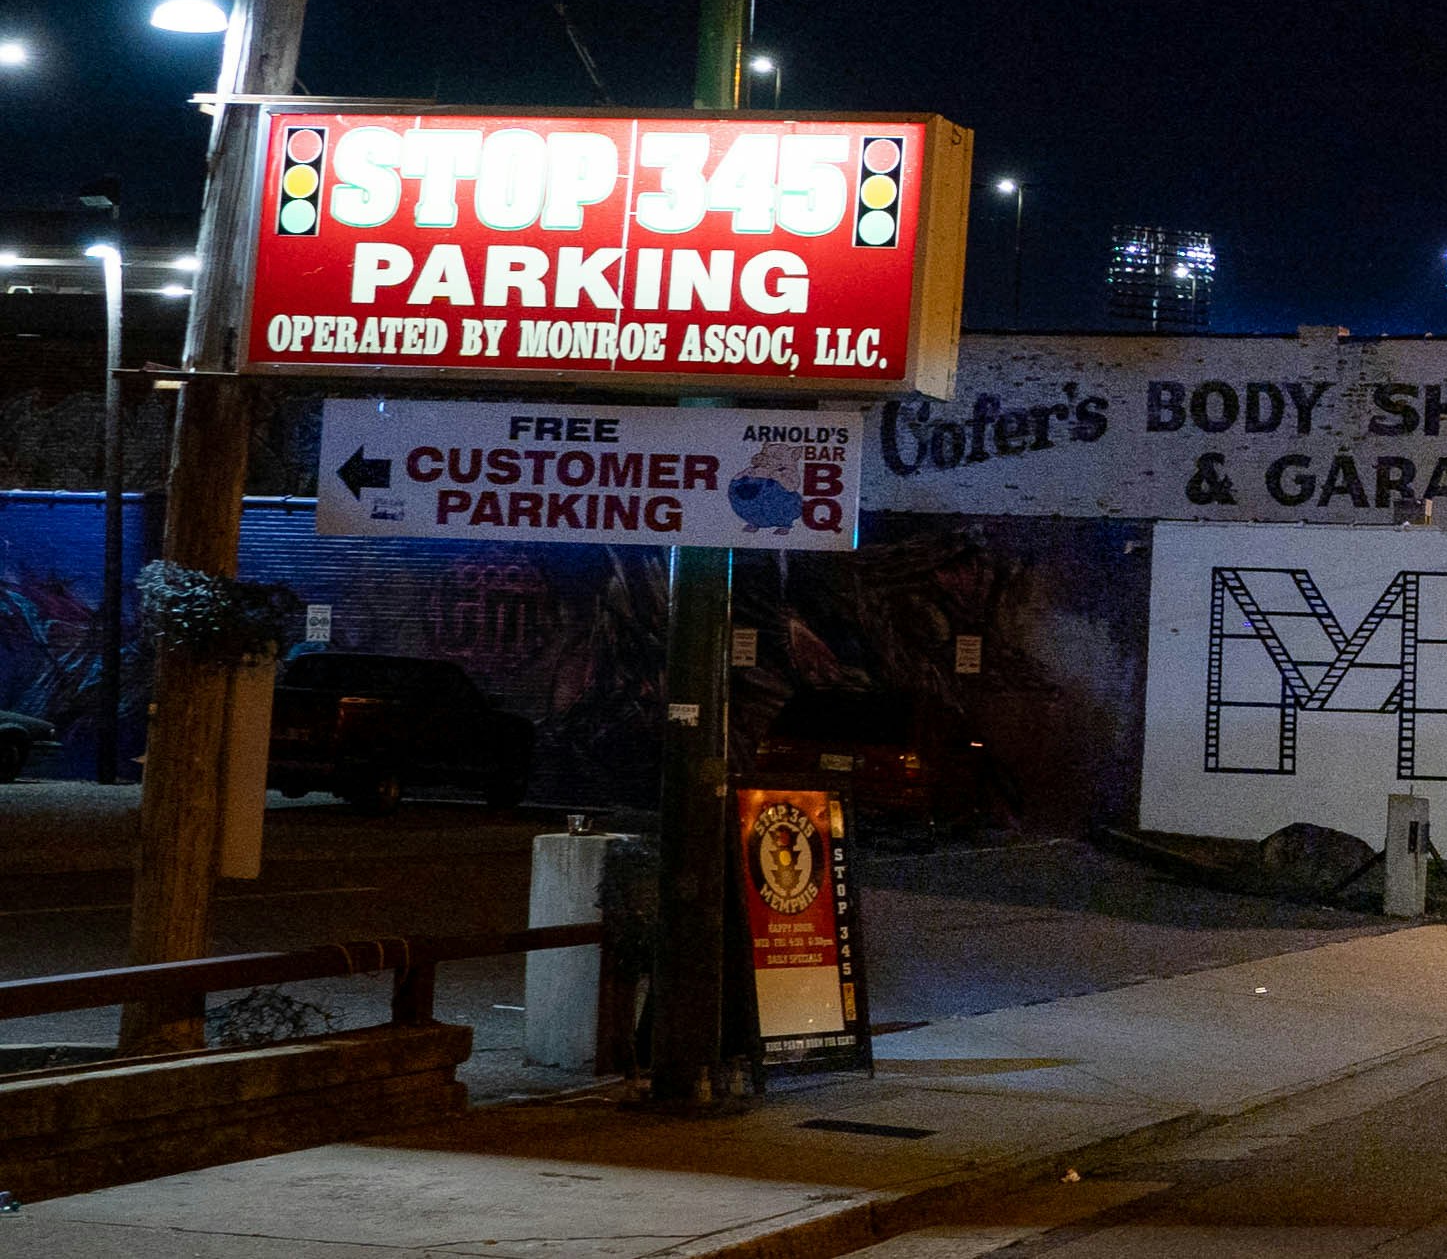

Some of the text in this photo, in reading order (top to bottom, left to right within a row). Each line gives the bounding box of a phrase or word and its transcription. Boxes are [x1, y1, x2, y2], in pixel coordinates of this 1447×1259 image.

[331, 127, 851, 237] STOP 345
[351, 242, 811, 314] PARKING
[267, 314, 888, 371] OPERATED BY MONROE ASSOC, LLC.
[509, 416, 620, 443] FREE
[1147, 380, 1335, 434] BODY
[743, 426, 849, 444] ARNOLD'S
[804, 446, 846, 462] BAR
[406, 446, 720, 492] CUSTOMER
[1186, 452, 1237, 506] &
[436, 490, 683, 532] PARKING
[754, 804, 815, 838] STOP 345
[760, 882, 818, 913] MEMPHIS
[833, 848, 848, 915] STOP
[839, 927, 852, 975] 345
